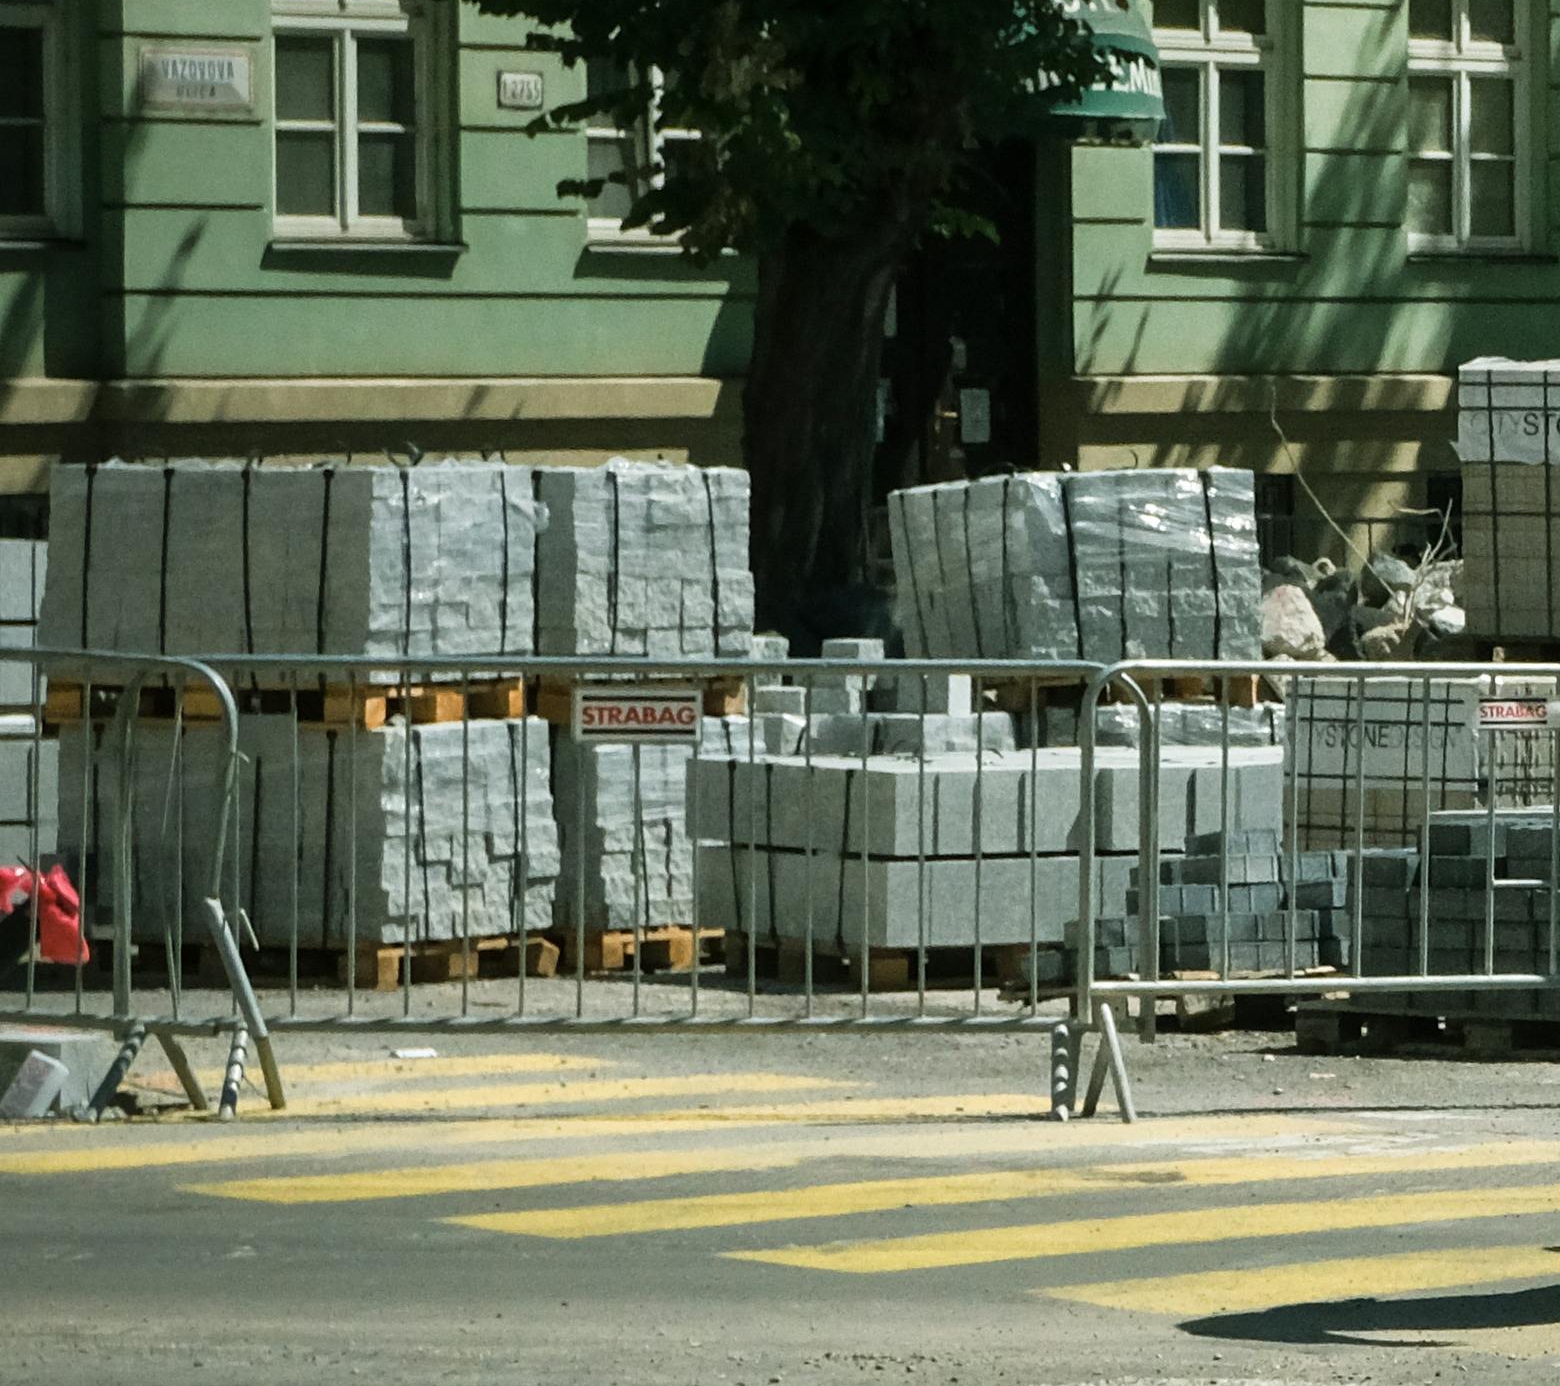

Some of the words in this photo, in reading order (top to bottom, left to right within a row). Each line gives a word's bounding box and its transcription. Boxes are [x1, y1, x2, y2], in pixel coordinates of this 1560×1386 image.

[161, 59, 234, 81] VAZOVOVA
[582, 706, 697, 726] STRABAG
[1480, 703, 1548, 720] STRABAG
